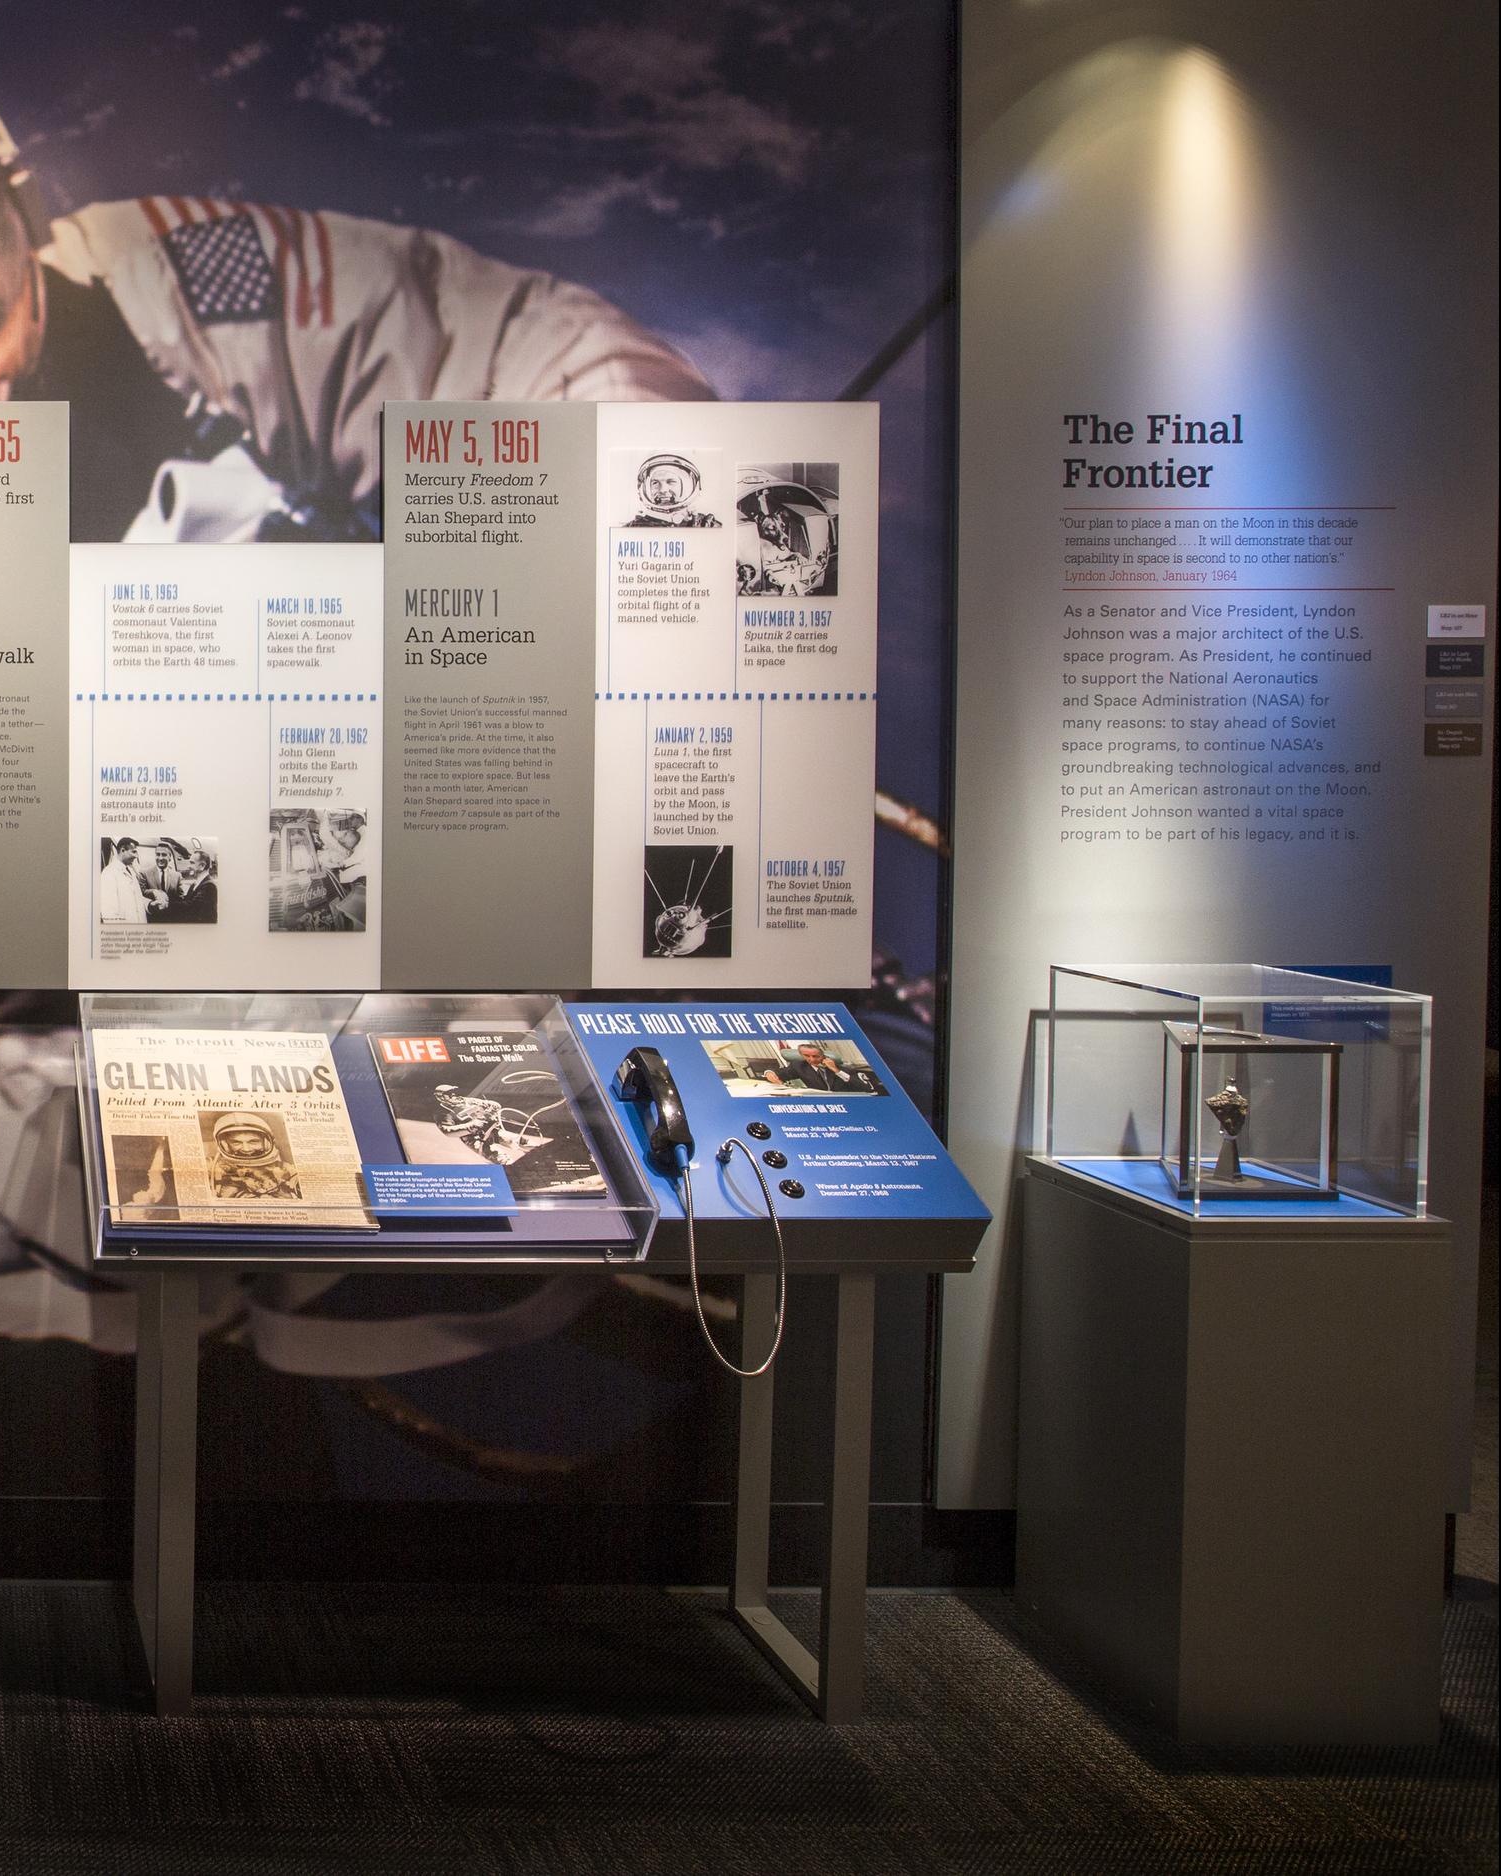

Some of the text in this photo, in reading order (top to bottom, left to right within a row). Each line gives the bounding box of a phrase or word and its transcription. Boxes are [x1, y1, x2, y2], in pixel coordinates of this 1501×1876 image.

[1064, 414, 1244, 445] The Final
[406, 420, 454, 463] MAY
[491, 420, 539, 463] 1961
[405, 473, 548, 489] Mercury Freedom 7
[1063, 457, 1214, 489] Frontier
[5, 491, 35, 505] first
[404, 492, 559, 505] carries U.S. astronaut
[404, 511, 536, 527] Alan Shepard into
[1088, 517, 1114, 531] plan
[1116, 519, 1129, 529] to
[1130, 517, 1162, 531] place
[1164, 519, 1172, 529] a
[1174, 519, 1200, 529] man
[1202, 519, 1218, 529] on
[1220, 517, 1240, 529] the
[1242, 516, 1275, 529] Moon
[1278, 518, 1290, 529] in
[1292, 516, 1315, 529] this
[1317, 516, 1358, 529] decade
[405, 529, 523, 546] suborbital flight.
[617, 541, 644, 558] APRIL
[664, 540, 685, 558] 1961
[1065, 569, 1238, 584] Lyndon Johnson, January 1964
[112, 583, 135, 601] JUNE
[155, 584, 178, 601] 1963
[267, 597, 299, 614] MARCH
[319, 598, 342, 615] 1965
[405, 588, 498, 618] MERCURY 1
[744, 610, 795, 627] NOVEMBER
[810, 610, 832, 628] 1957
[1063, 604, 1356, 620] As a Senator and Vice President, Lyndon
[404, 626, 536, 644] An American
[1063, 626, 1363, 642] Johnson was a major architect of the U.S.
[404, 648, 488, 668] in Space
[279, 727, 326, 744] FEBRUARY
[346, 727, 368, 745] 1962
[654, 726, 695, 744] JANUARY
[710, 726, 733, 744] 1959
[766, 860, 808, 878] OCTOBER
[824, 860, 846, 878] 1957
[766, 880, 852, 890] The Soviet Union
[766, 893, 855, 904] launches Sputnik,
[766, 906, 858, 916] the first man-made
[766, 919, 809, 929] satellite.
[577, 1013, 845, 1034] PLEASE HOLD FOR THE PRESIDENT
[467, 1036, 492, 1044] PAGES
[494, 1036, 504, 1044] OF
[382, 1040, 447, 1061] LIFE
[471, 1044, 539, 1053] FANTASTIC COLOR
[457, 1053, 524, 1063] The Space Walk
[103, 1061, 334, 1093] GLENN LANDS
[107, 1097, 341, 1110] Pulled From Atlantic After 3 Orbits
[768, 1104, 848, 1114] CONVERSATIONS ON SPACE
